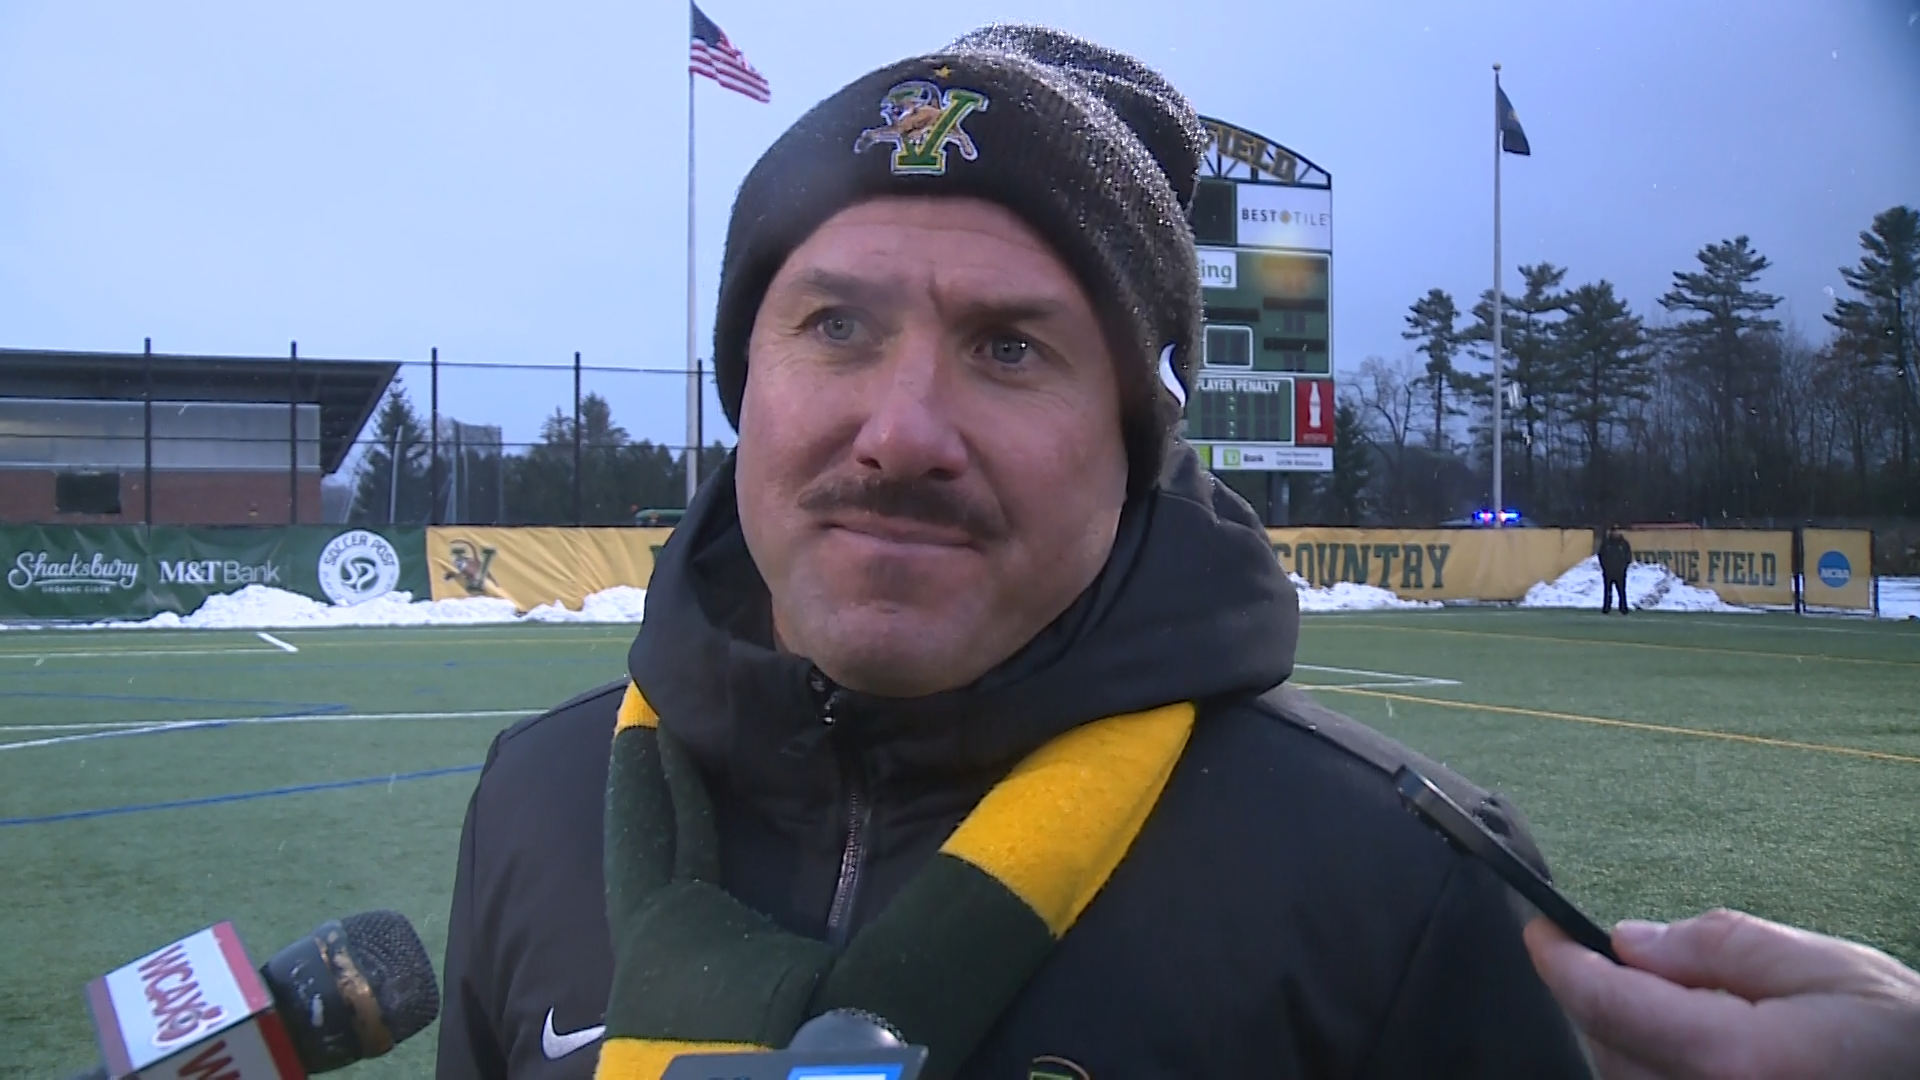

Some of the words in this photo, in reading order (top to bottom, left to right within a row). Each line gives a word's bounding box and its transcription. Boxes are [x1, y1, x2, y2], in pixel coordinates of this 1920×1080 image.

[1242, 208, 1277, 222] BEST
[1293, 211, 1328, 226] TILE
[1195, 379, 1234, 392] PLAYER
[1235, 380, 1280, 394] PENALTY
[324, 533, 368, 566] SOCCER
[370, 539, 396, 566] POST
[8, 551, 139, 589] Shacksbury
[159, 560, 221, 583] M&T
[223, 560, 280, 583] Bank
[1707, 551, 1776, 586] FIELD
